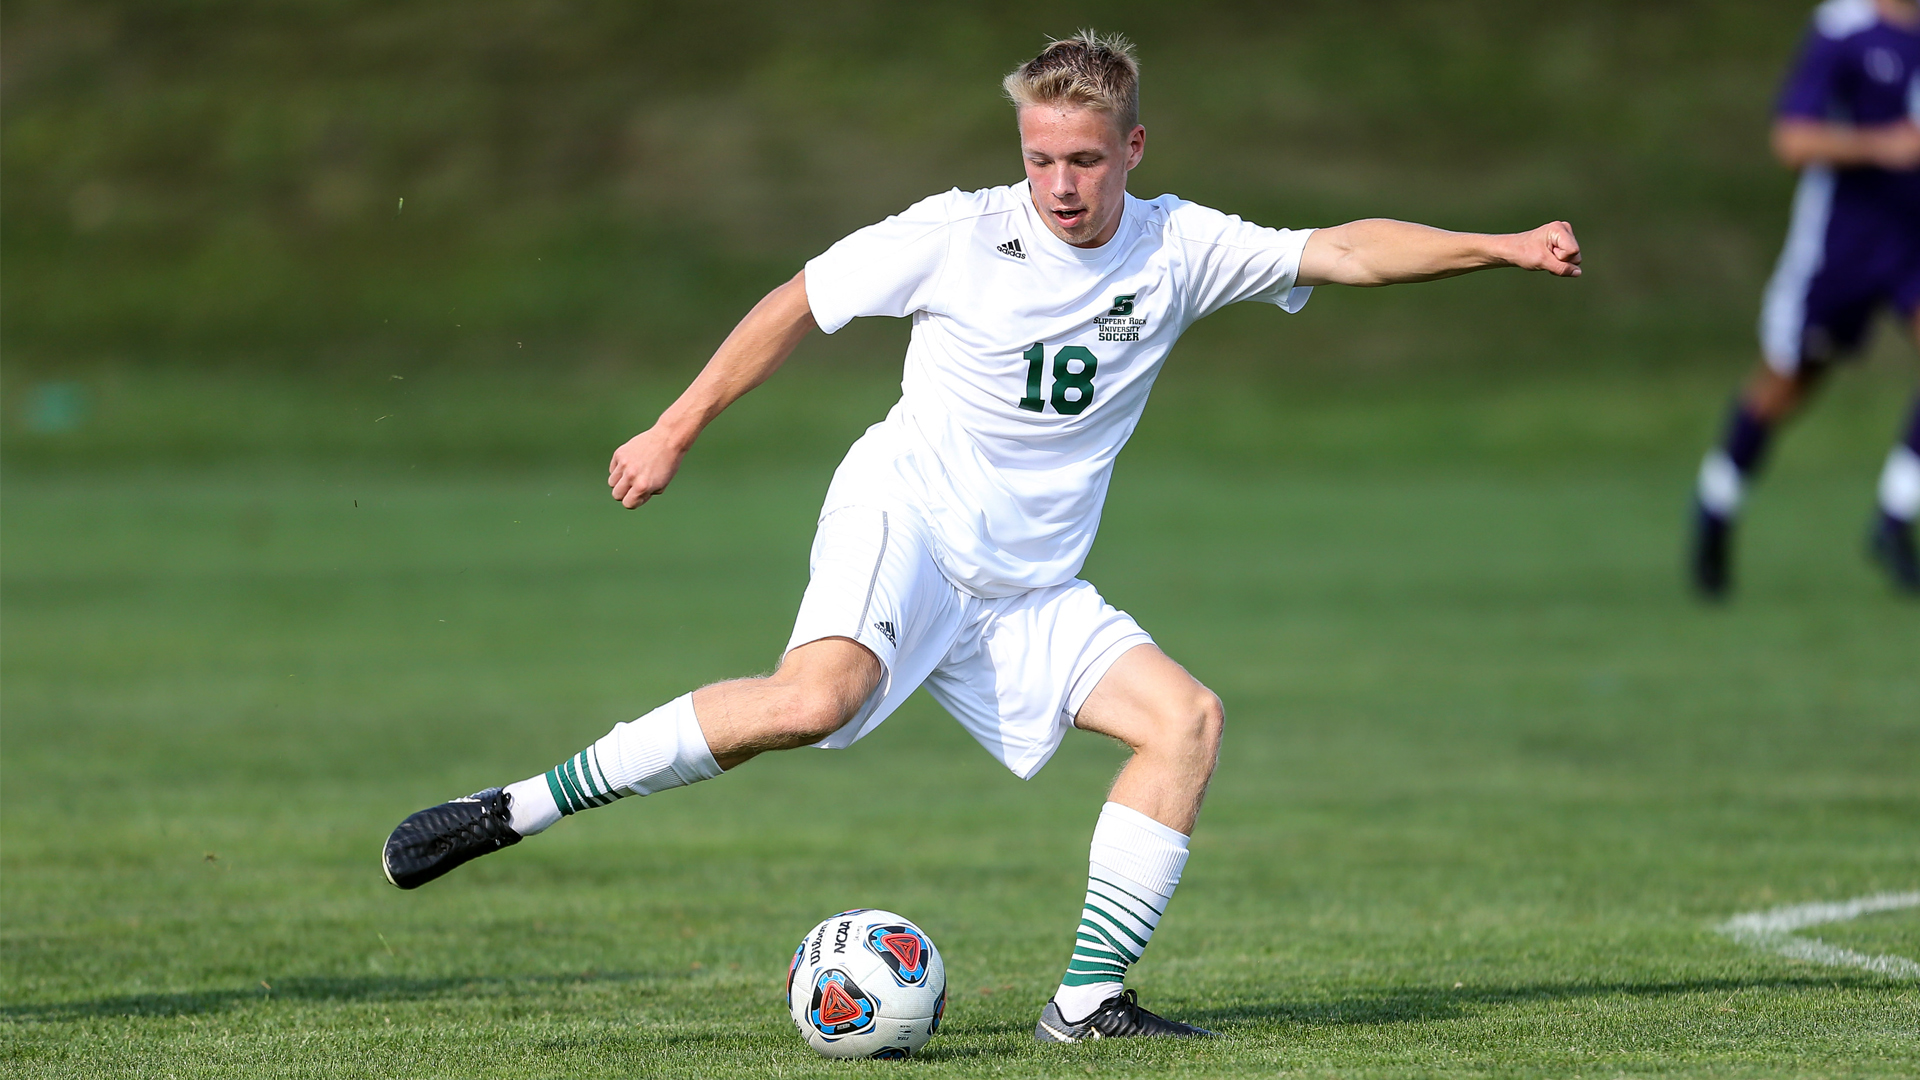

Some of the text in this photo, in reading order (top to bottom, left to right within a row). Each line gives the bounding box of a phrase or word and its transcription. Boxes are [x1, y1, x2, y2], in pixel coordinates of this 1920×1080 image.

[996, 245, 1026, 260] adidas
[1098, 332, 1139, 341] SOCCER
[1018, 342, 1098, 415] 18
[833, 920, 853, 954] NCAA
